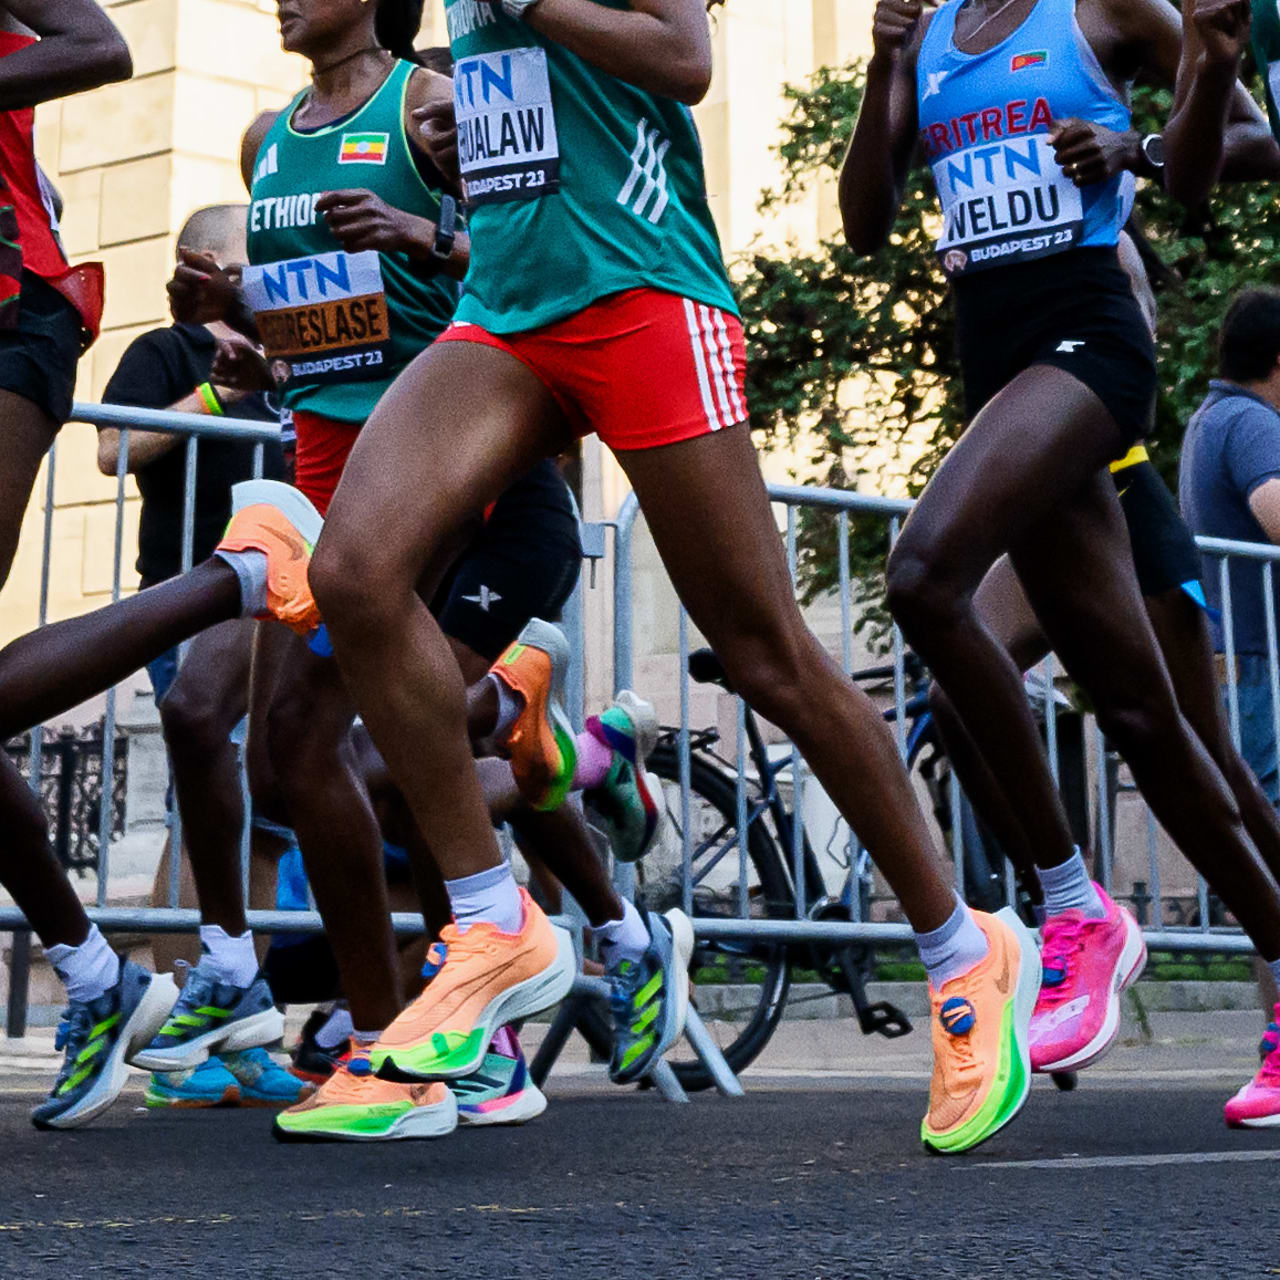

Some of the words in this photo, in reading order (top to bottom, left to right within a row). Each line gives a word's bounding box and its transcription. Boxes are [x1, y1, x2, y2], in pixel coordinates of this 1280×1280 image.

[525, 169, 546, 188] 23
[946, 137, 1042, 196] NTN
[970, 235, 1052, 263] BUDAPEST
[1053, 228, 1074, 245] 23
[262, 253, 351, 304] NTN
[291, 353, 363, 377] BUDAPEST
[364, 349, 384, 367] 23
